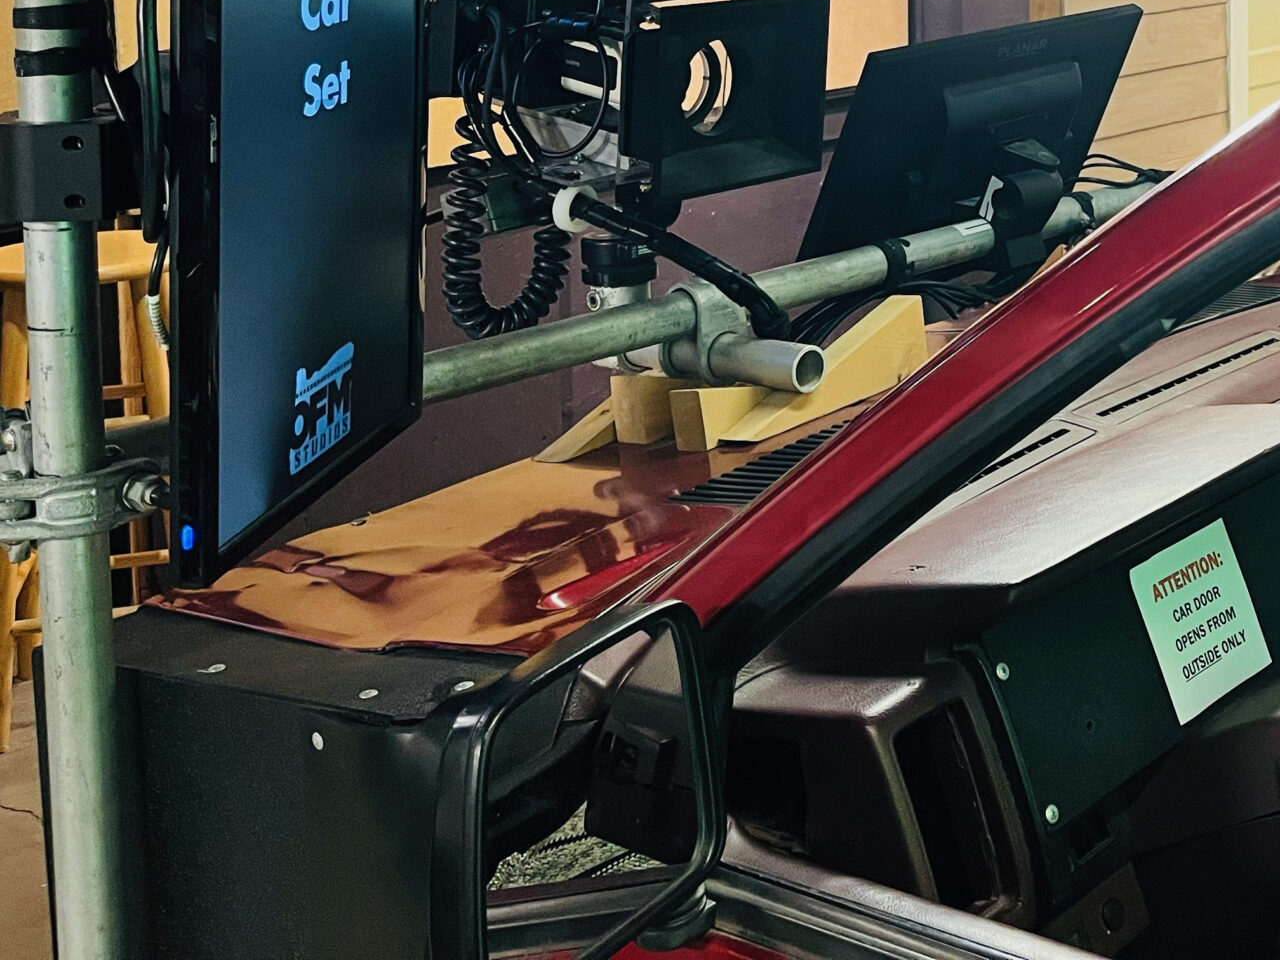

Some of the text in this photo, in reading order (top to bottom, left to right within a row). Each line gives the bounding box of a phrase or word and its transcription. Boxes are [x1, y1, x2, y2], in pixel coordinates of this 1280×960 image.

[302, 60, 351, 117] Set
[294, 416, 349, 468] STUDIOS
[1152, 551, 1223, 603] ATTENTION:
[1172, 586, 1221, 622] CAR DOOR
[1175, 606, 1237, 653] OPENS FROM
[1182, 629, 1247, 679] OUTSIDE ONLY
